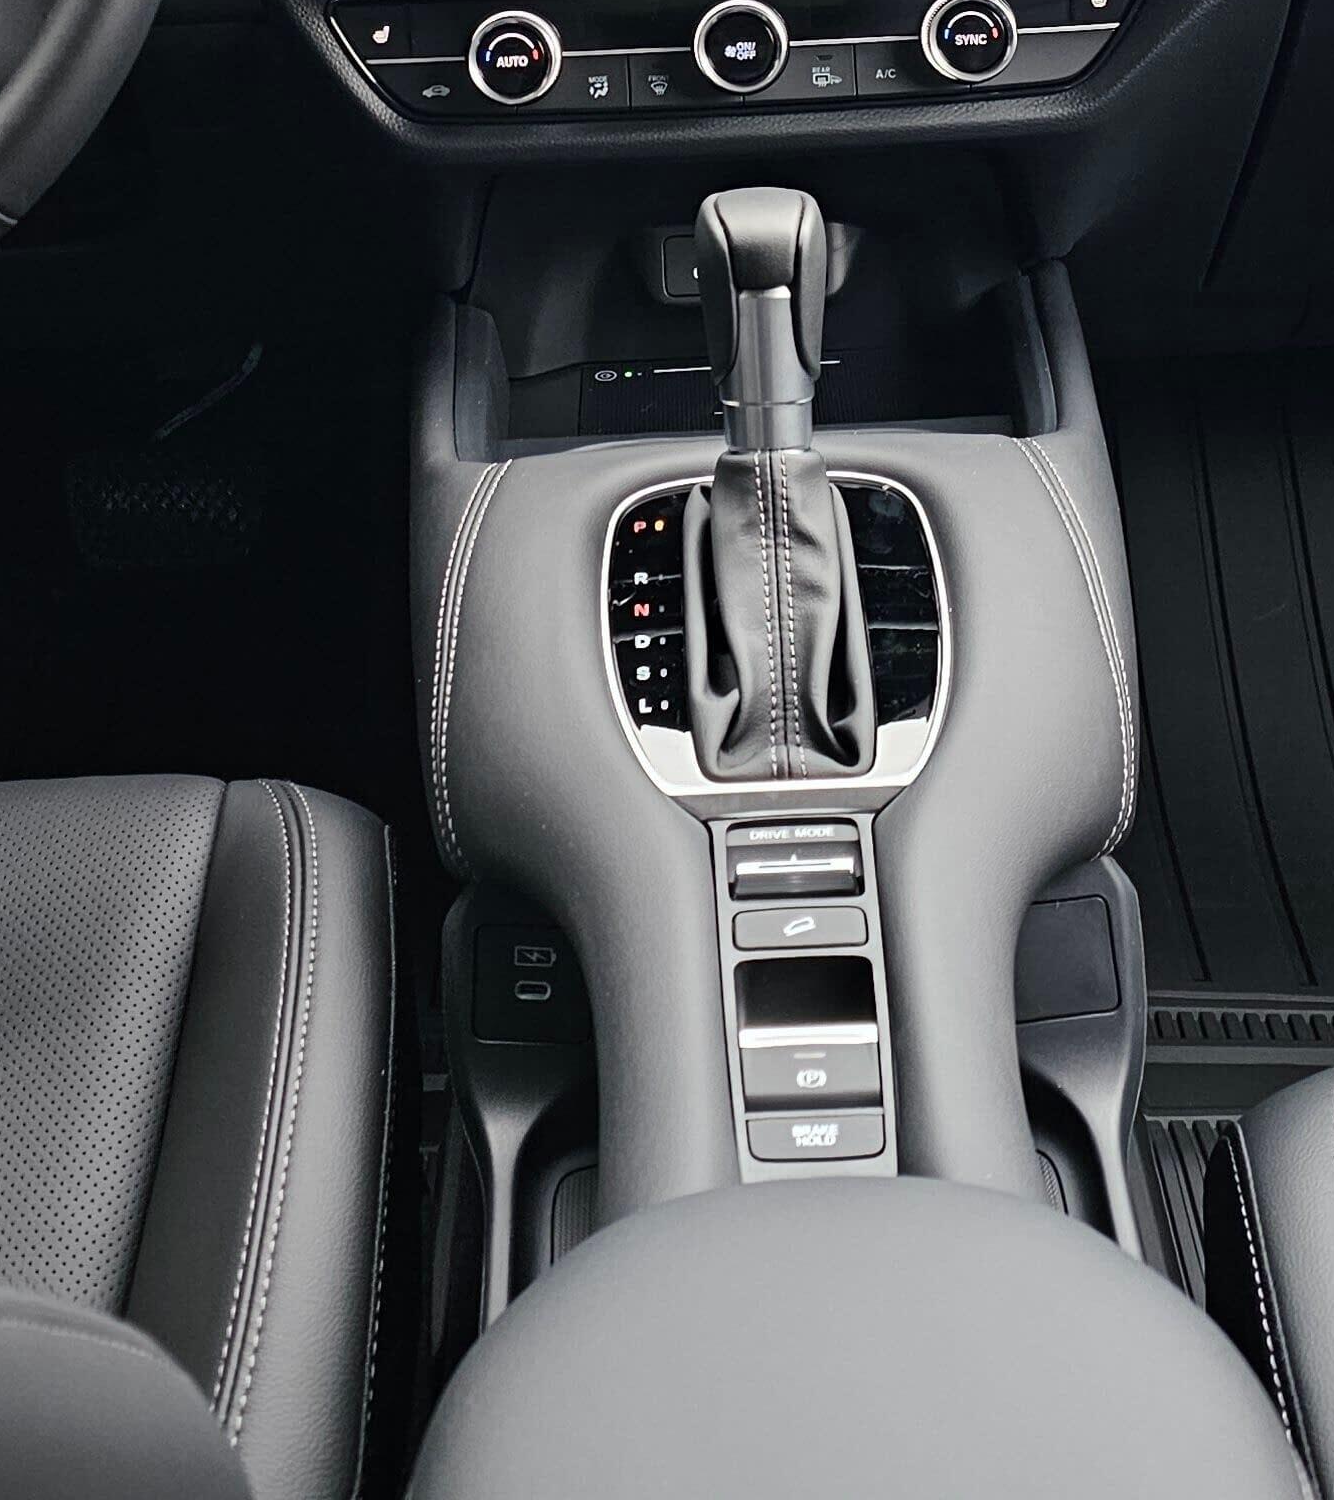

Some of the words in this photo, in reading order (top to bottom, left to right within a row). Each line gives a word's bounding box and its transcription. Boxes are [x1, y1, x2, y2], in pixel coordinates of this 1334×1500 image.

[955, 33, 987, 46] SYNC
[736, 42, 756, 50] ON/
[737, 50, 756, 60] OFF
[496, 55, 529, 68] AUTO
[875, 68, 896, 79] A/C
[633, 521, 646, 533] P
[634, 572, 649, 584] R
[634, 604, 649, 616] N
[635, 635, 651, 648] D
[636, 666, 651, 680] S
[638, 698, 652, 713] L
[749, 830, 790, 840] DRIVE
[795, 827, 834, 838] MODE
[792, 1124, 839, 1137] BRAKE
[795, 1136, 837, 1148] HOLD
